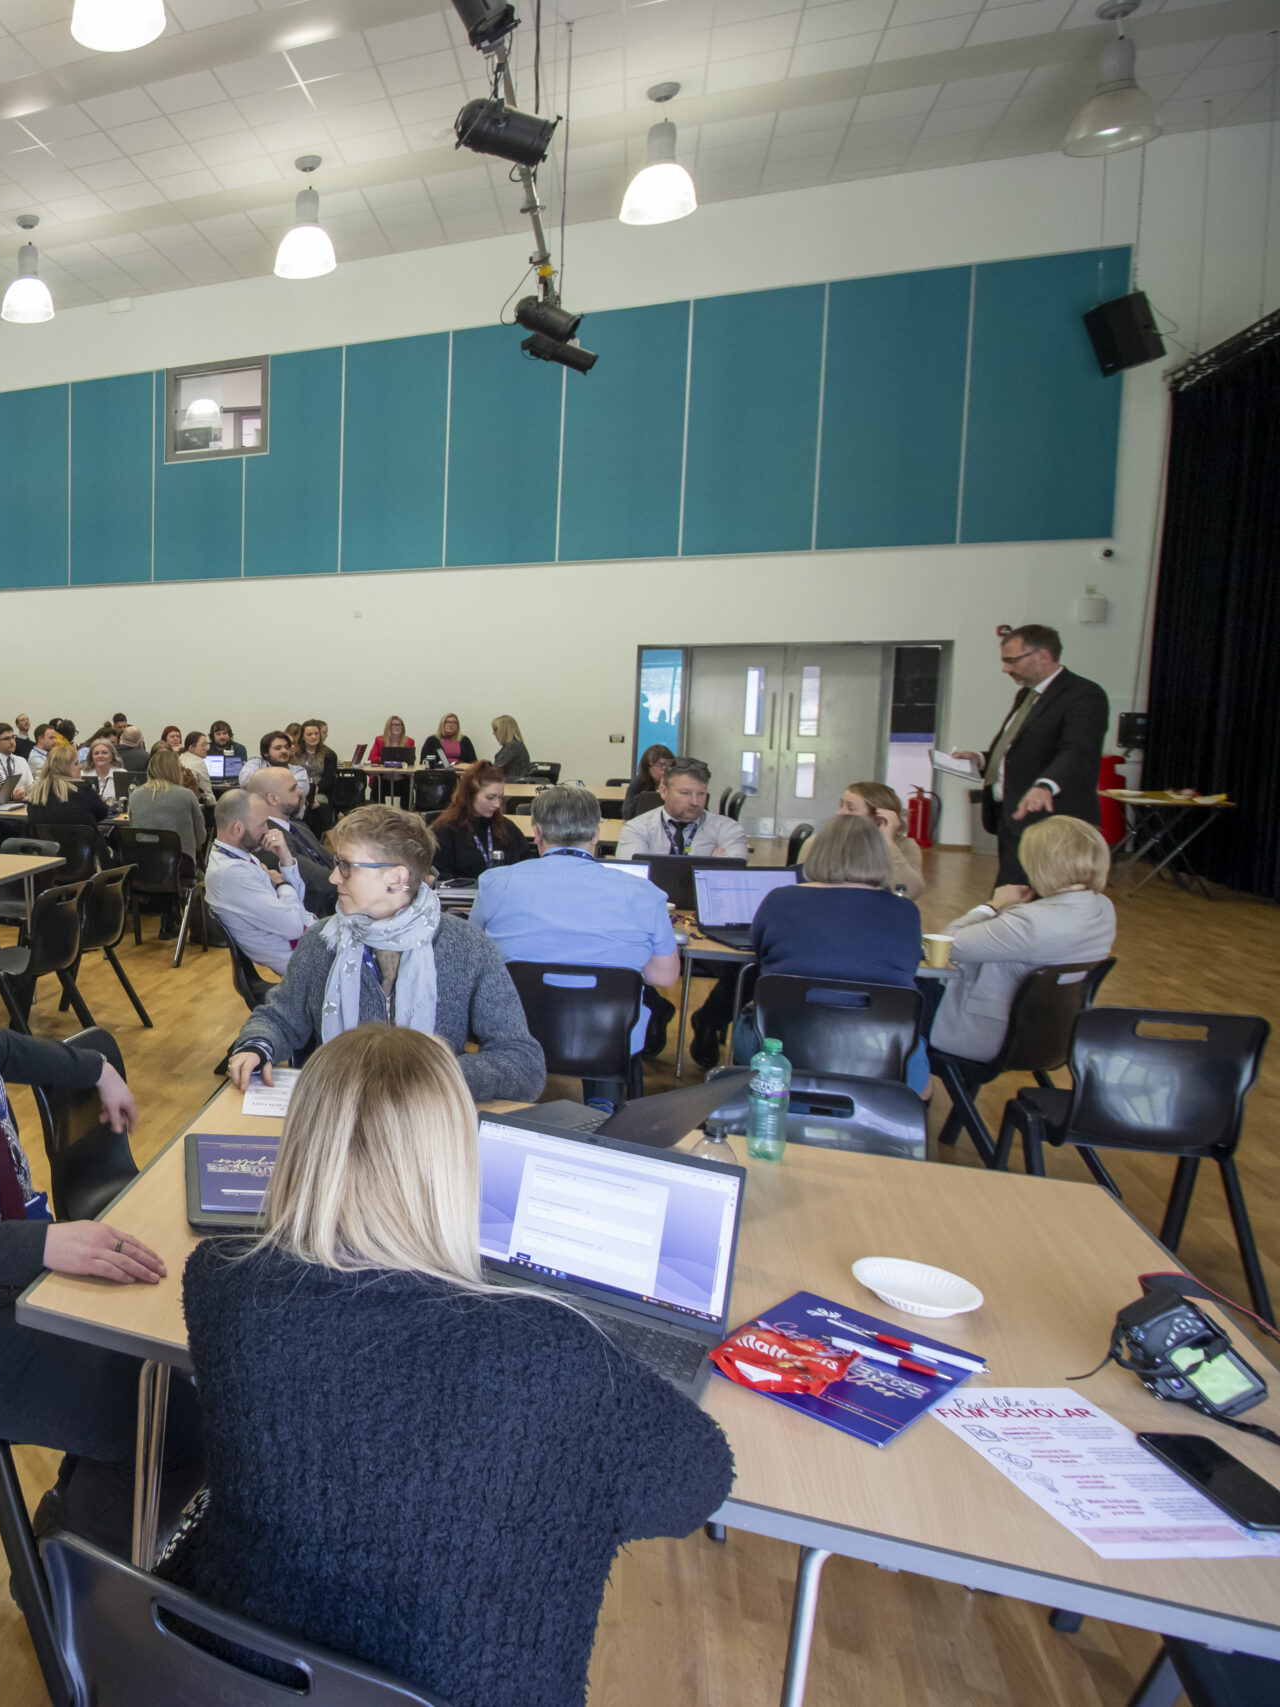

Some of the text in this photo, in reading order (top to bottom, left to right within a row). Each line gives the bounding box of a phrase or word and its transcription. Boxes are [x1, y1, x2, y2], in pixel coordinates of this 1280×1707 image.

[953, 1398, 989, 1411] Read
[993, 1396, 1024, 1408] like
[935, 1408, 1099, 1418] FILM SCHOLAR
